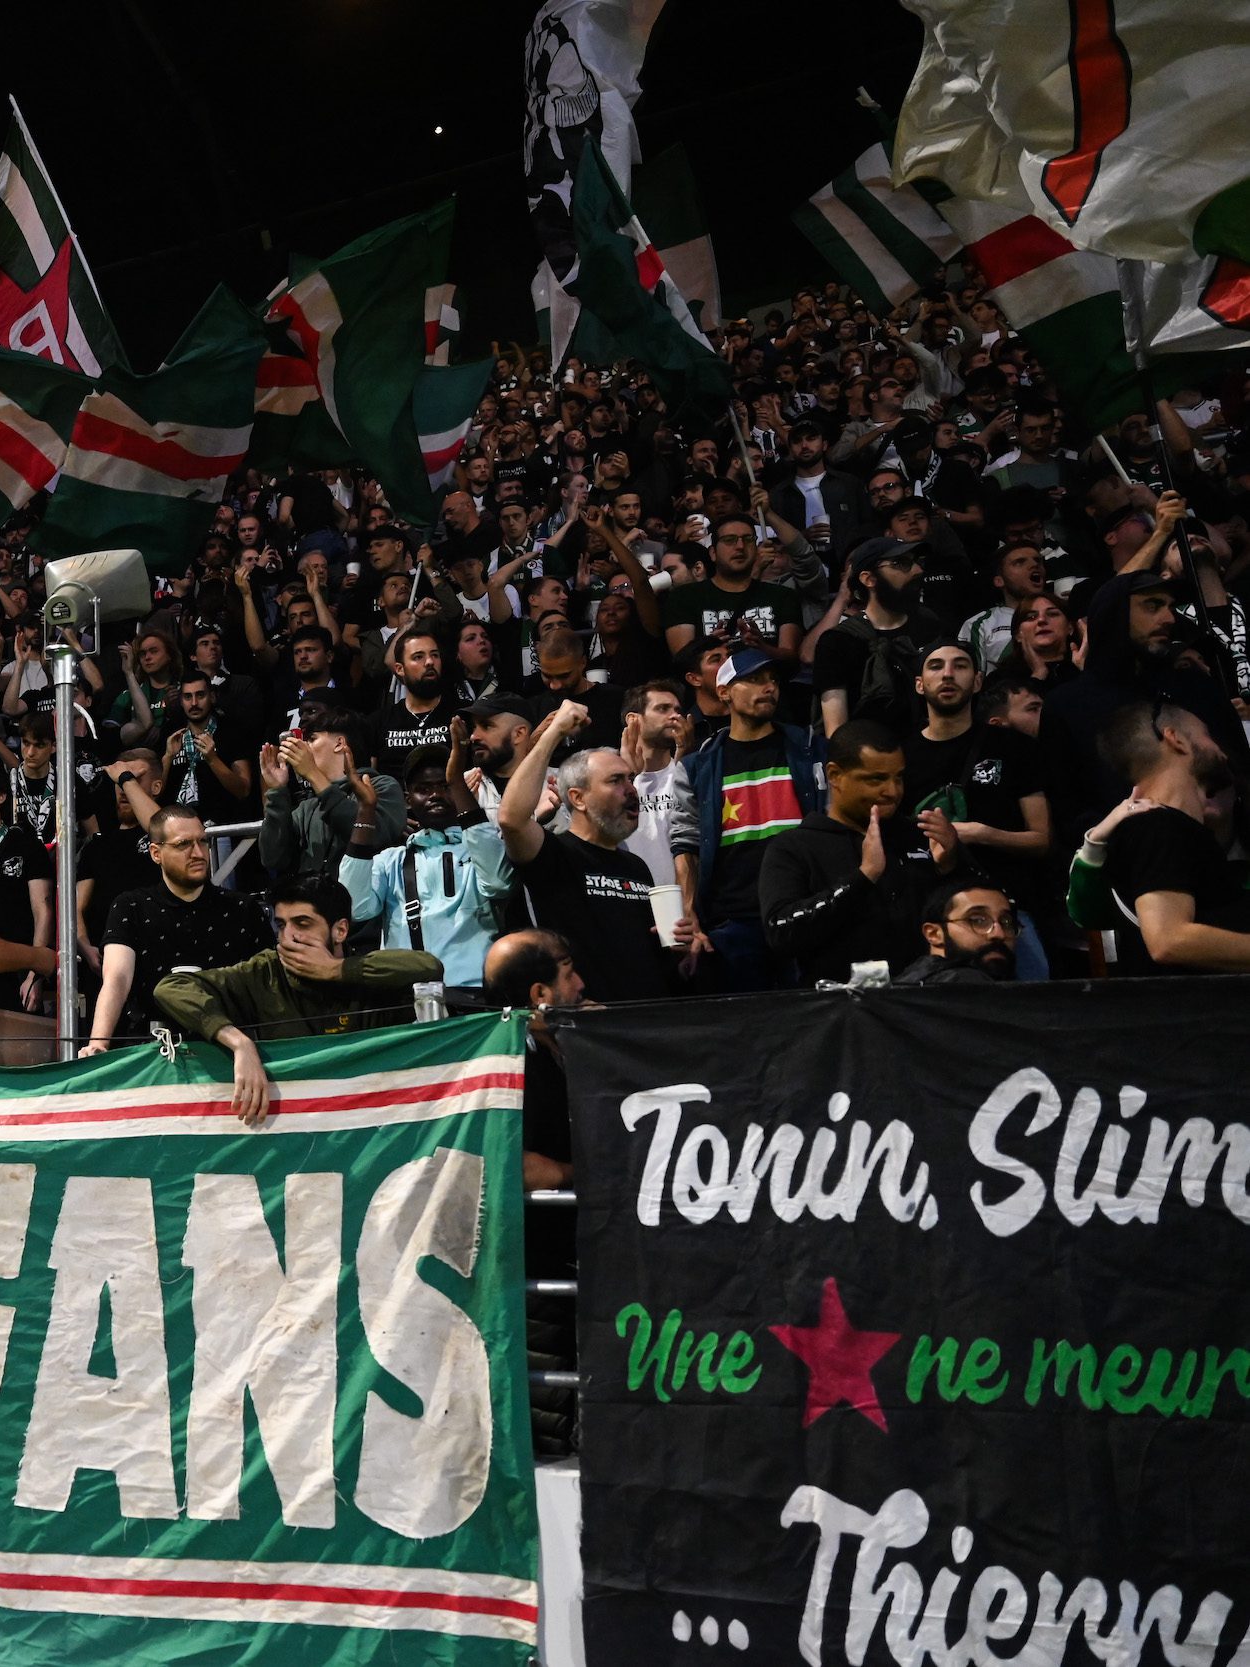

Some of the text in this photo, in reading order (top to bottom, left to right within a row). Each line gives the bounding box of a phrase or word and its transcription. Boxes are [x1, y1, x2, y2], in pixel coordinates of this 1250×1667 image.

[388, 726, 448, 738] TRIBUNE RINO
[387, 735, 447, 747] DELLA NEGRA
[585, 875, 622, 890] STADE
[619, 1083, 939, 1231] Tonin,
[615, 1302, 762, 1404] Une
[904, 1333, 1009, 1406] ne
